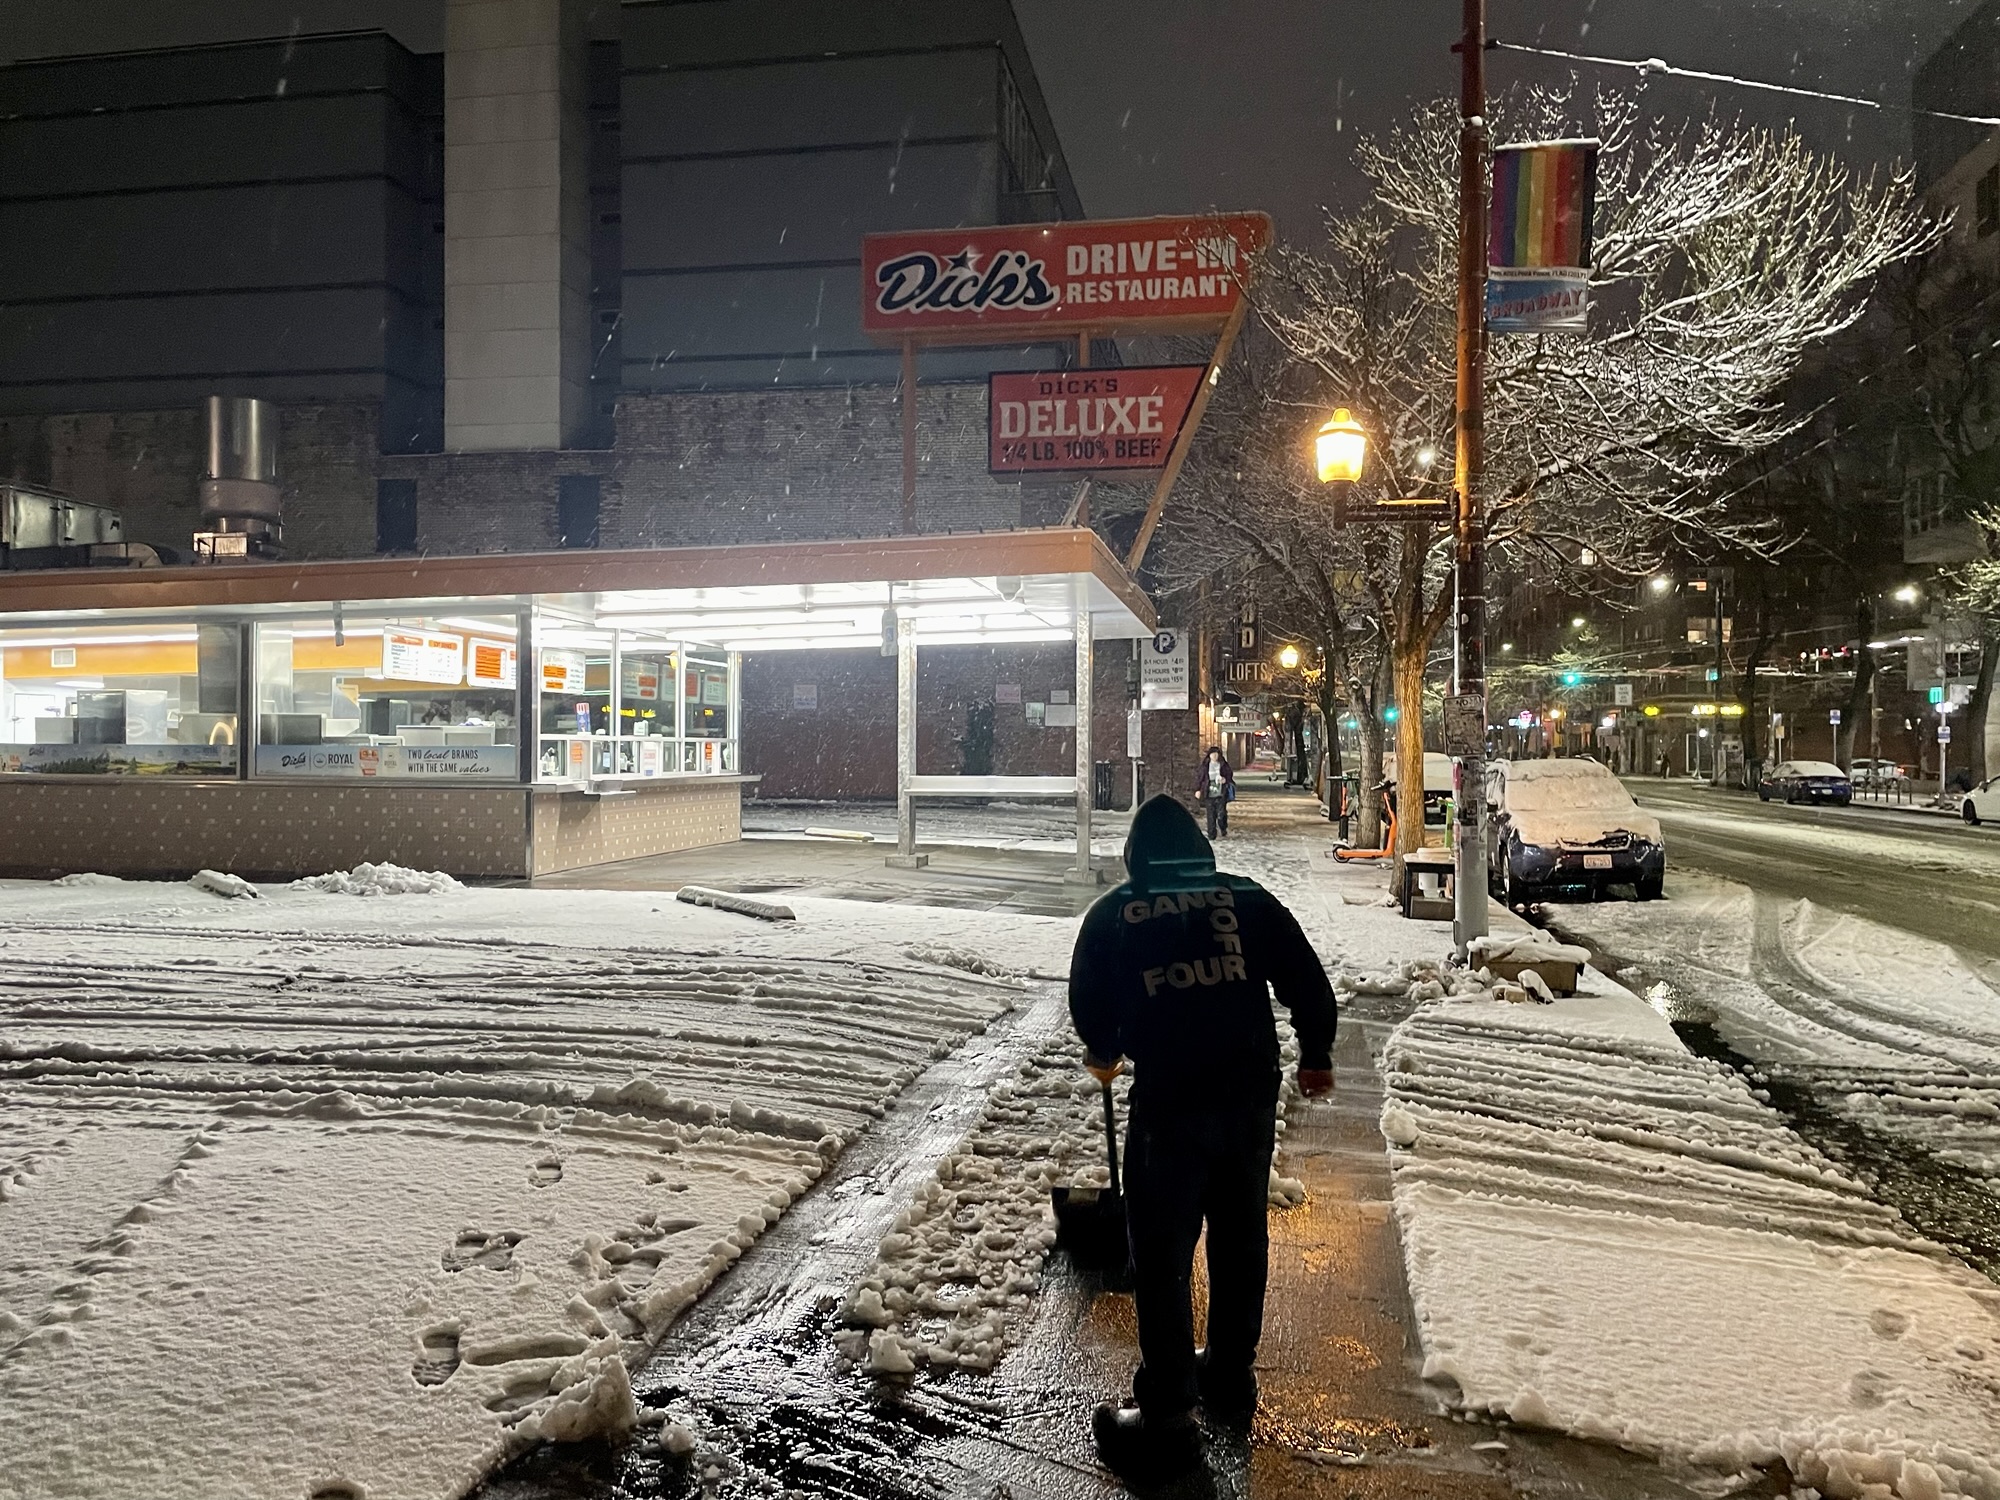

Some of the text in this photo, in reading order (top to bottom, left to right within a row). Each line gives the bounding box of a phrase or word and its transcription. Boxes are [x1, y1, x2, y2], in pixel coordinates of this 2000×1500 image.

[1066, 236, 1237, 276] DRIVE-IN
[877, 248, 1058, 312] Dick's
[1066, 274, 1233, 304] RESTAURANT
[1039, 378, 1119, 395] DICK'S
[999, 396, 1164, 439] DELUXE
[1032, 441, 1060, 461] LB.
[1064, 439, 1110, 461] 100%
[1115, 438, 1162, 459] BEEF
[1229, 662, 1268, 681] LOFTS
[328, 753, 354, 765] ROYAL
[408, 749, 479, 760] TWO local BRANDS
[408, 763, 491, 773] WITH THE SAME values
[1123, 885, 1235, 924] GANG
[1142, 955, 1248, 998] FOUR
